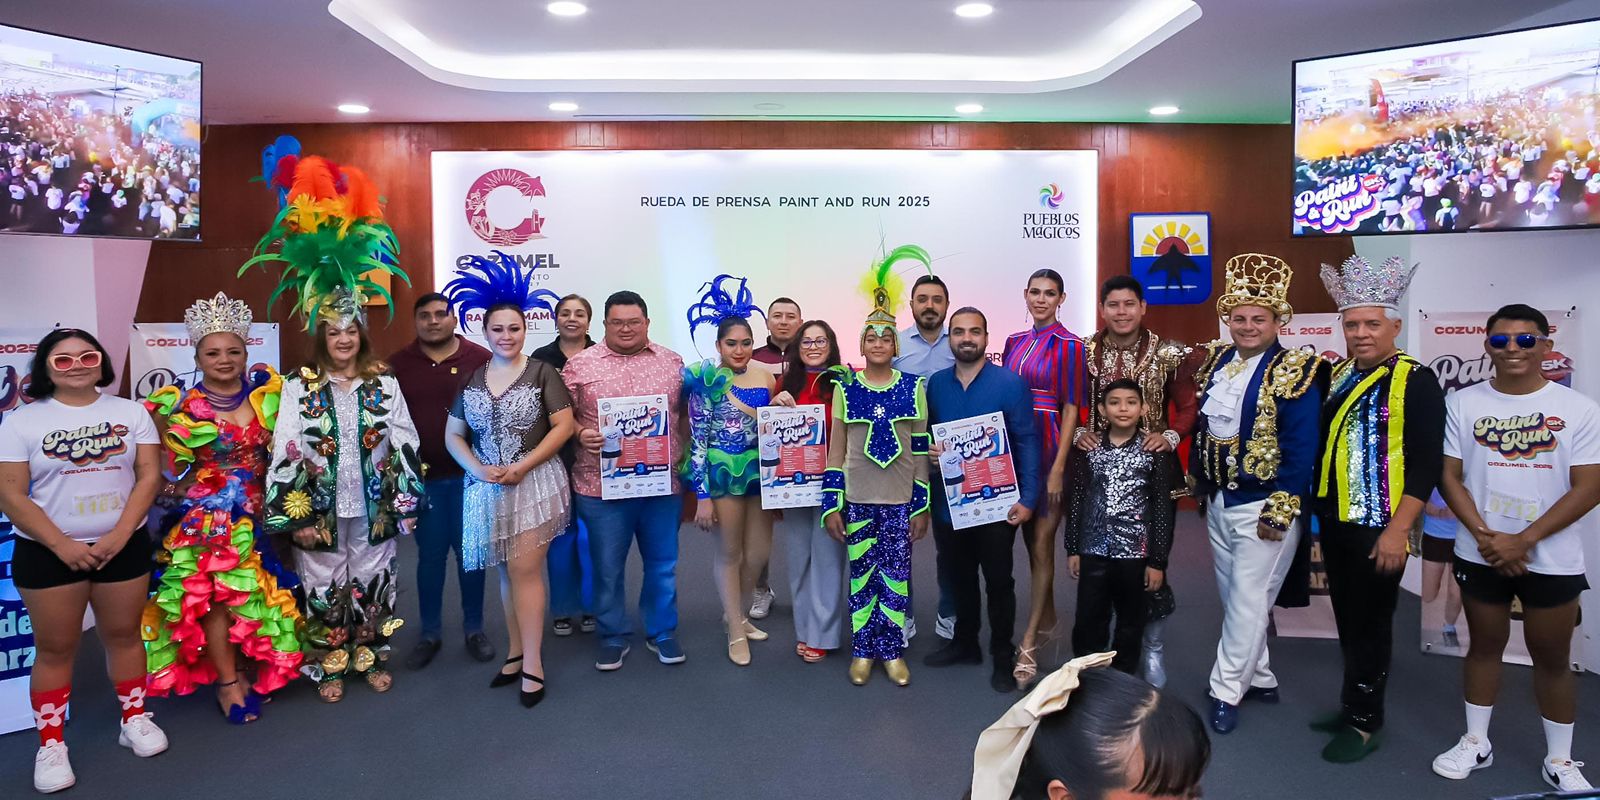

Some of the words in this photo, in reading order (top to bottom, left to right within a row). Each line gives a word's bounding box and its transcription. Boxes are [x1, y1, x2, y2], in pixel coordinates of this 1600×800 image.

[640, 196, 686, 207] RUEDA
[692, 196, 710, 207] DE
[716, 196, 771, 207] PRENSA
[779, 196, 819, 207] PAINT
[824, 196, 854, 207] AND
[862, 196, 890, 207] RUN
[898, 195, 930, 207] 2025
[1294, 174, 1359, 216] Paint
[1321, 191, 1372, 226] Run
[1300, 327, 1332, 335] 2025
[1434, 326, 1489, 335] COZUM
[1541, 357, 1569, 370] 5K
[624, 417, 653, 435] Run
[1474, 412, 1540, 437] Paint
[44, 422, 109, 451] Paint
[783, 426, 811, 442] Run
[1487, 431, 1499, 442] &
[1501, 428, 1551, 451] Run
[56, 442, 69, 453] &
[71, 435, 121, 459] Run
[963, 436, 992, 457] Run
[636, 464, 645, 474] 3
[796, 473, 803, 483] 3
[983, 486, 992, 497] 3
